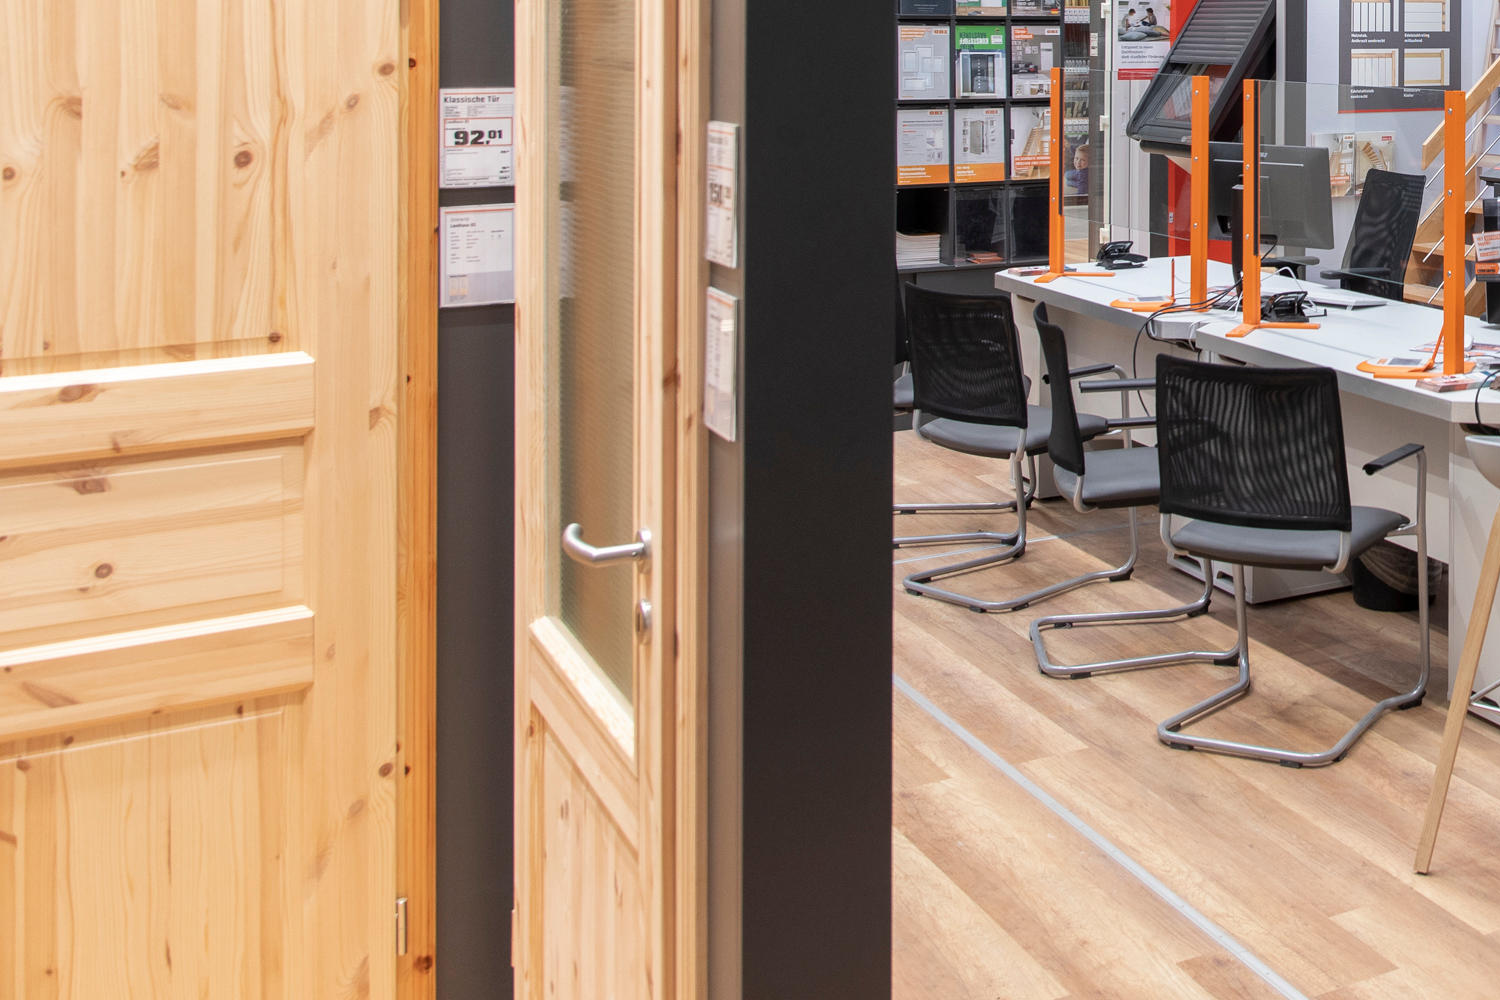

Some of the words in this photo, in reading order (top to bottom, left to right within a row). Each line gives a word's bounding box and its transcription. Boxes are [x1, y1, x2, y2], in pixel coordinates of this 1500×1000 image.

[443, 95, 485, 104] Klassische
[487, 95, 501, 103] Tür
[454, 129, 503, 146] 92,01
